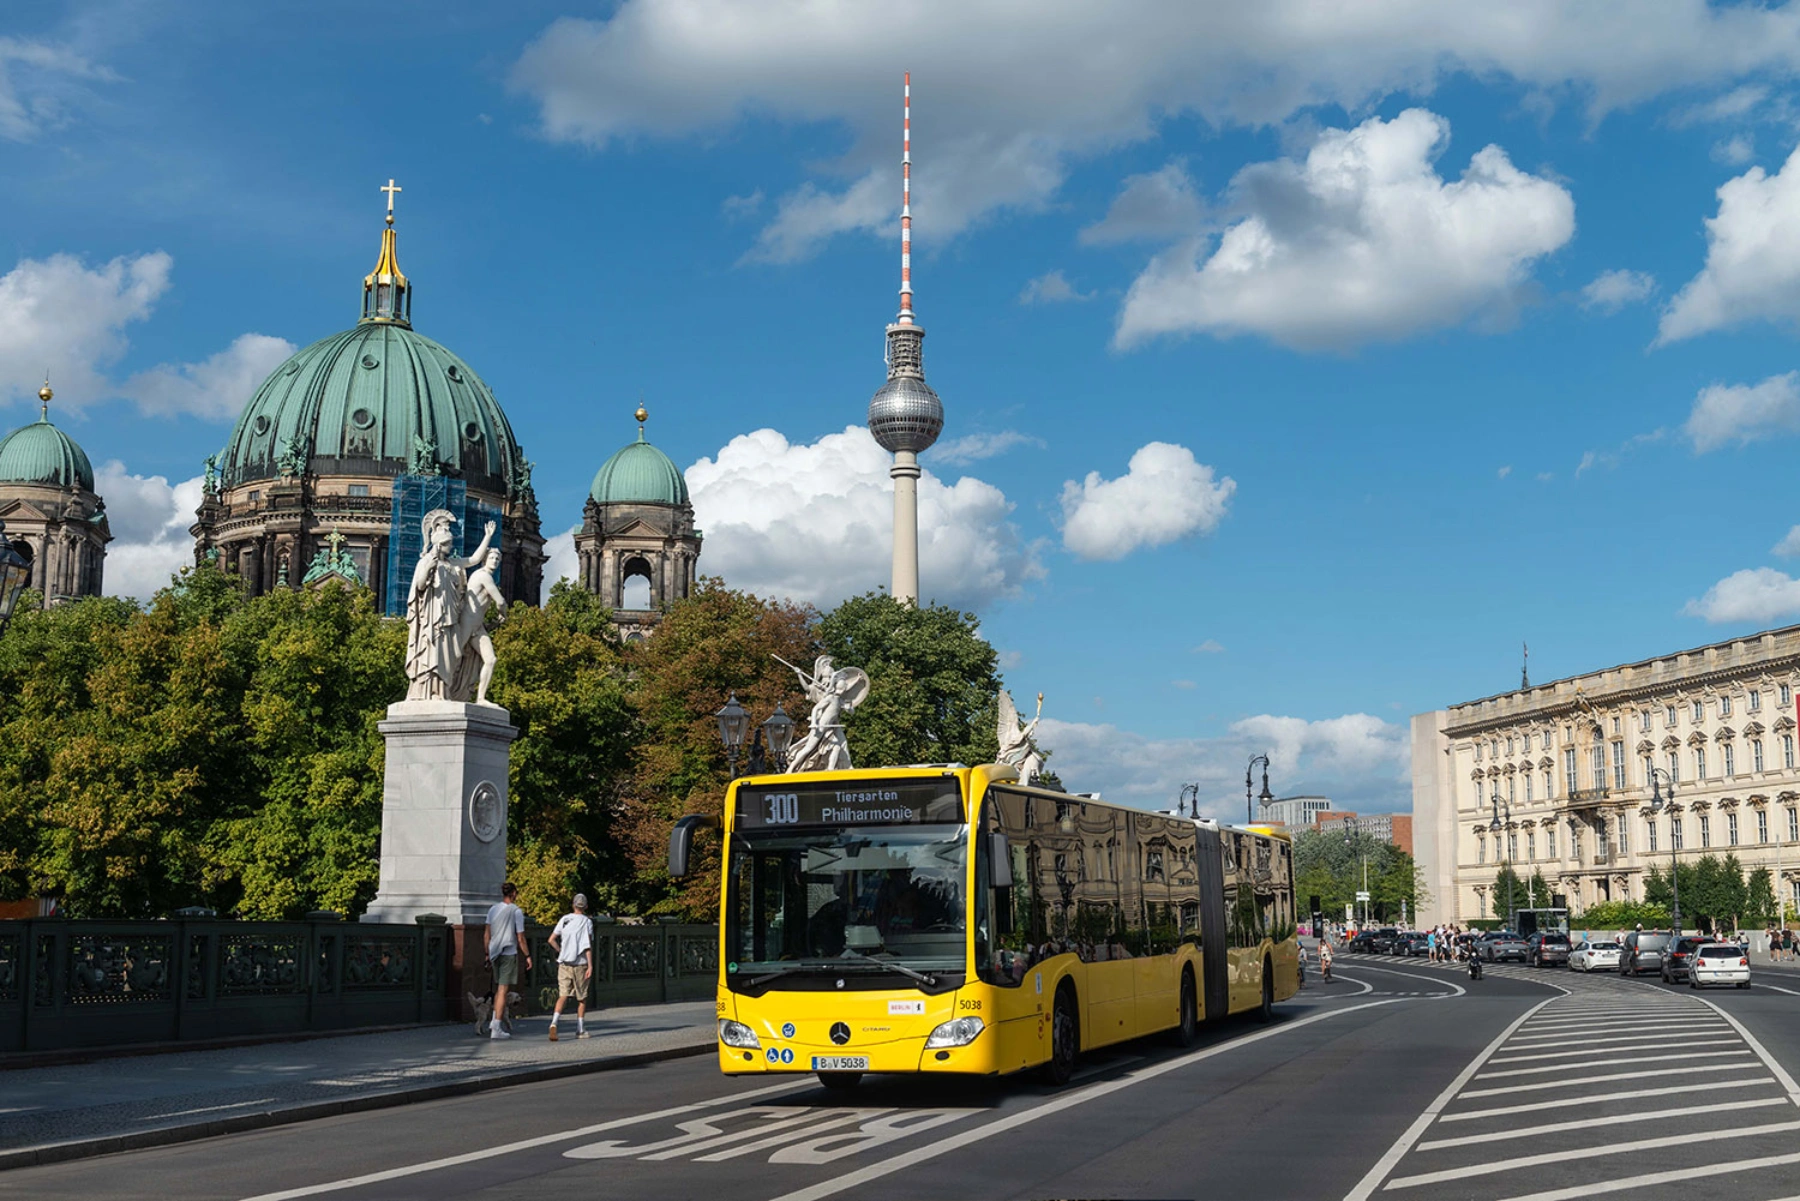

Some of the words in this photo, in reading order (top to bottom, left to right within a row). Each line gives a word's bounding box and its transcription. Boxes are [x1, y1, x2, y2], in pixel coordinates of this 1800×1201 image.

[834, 790, 898, 803] Tiergarten
[764, 793, 799, 824] 300
[822, 805, 913, 822] Philharmonie
[959, 999, 982, 1010] 5038
[820, 1057, 827, 1069] B
[840, 1057, 865, 1069] 5038
